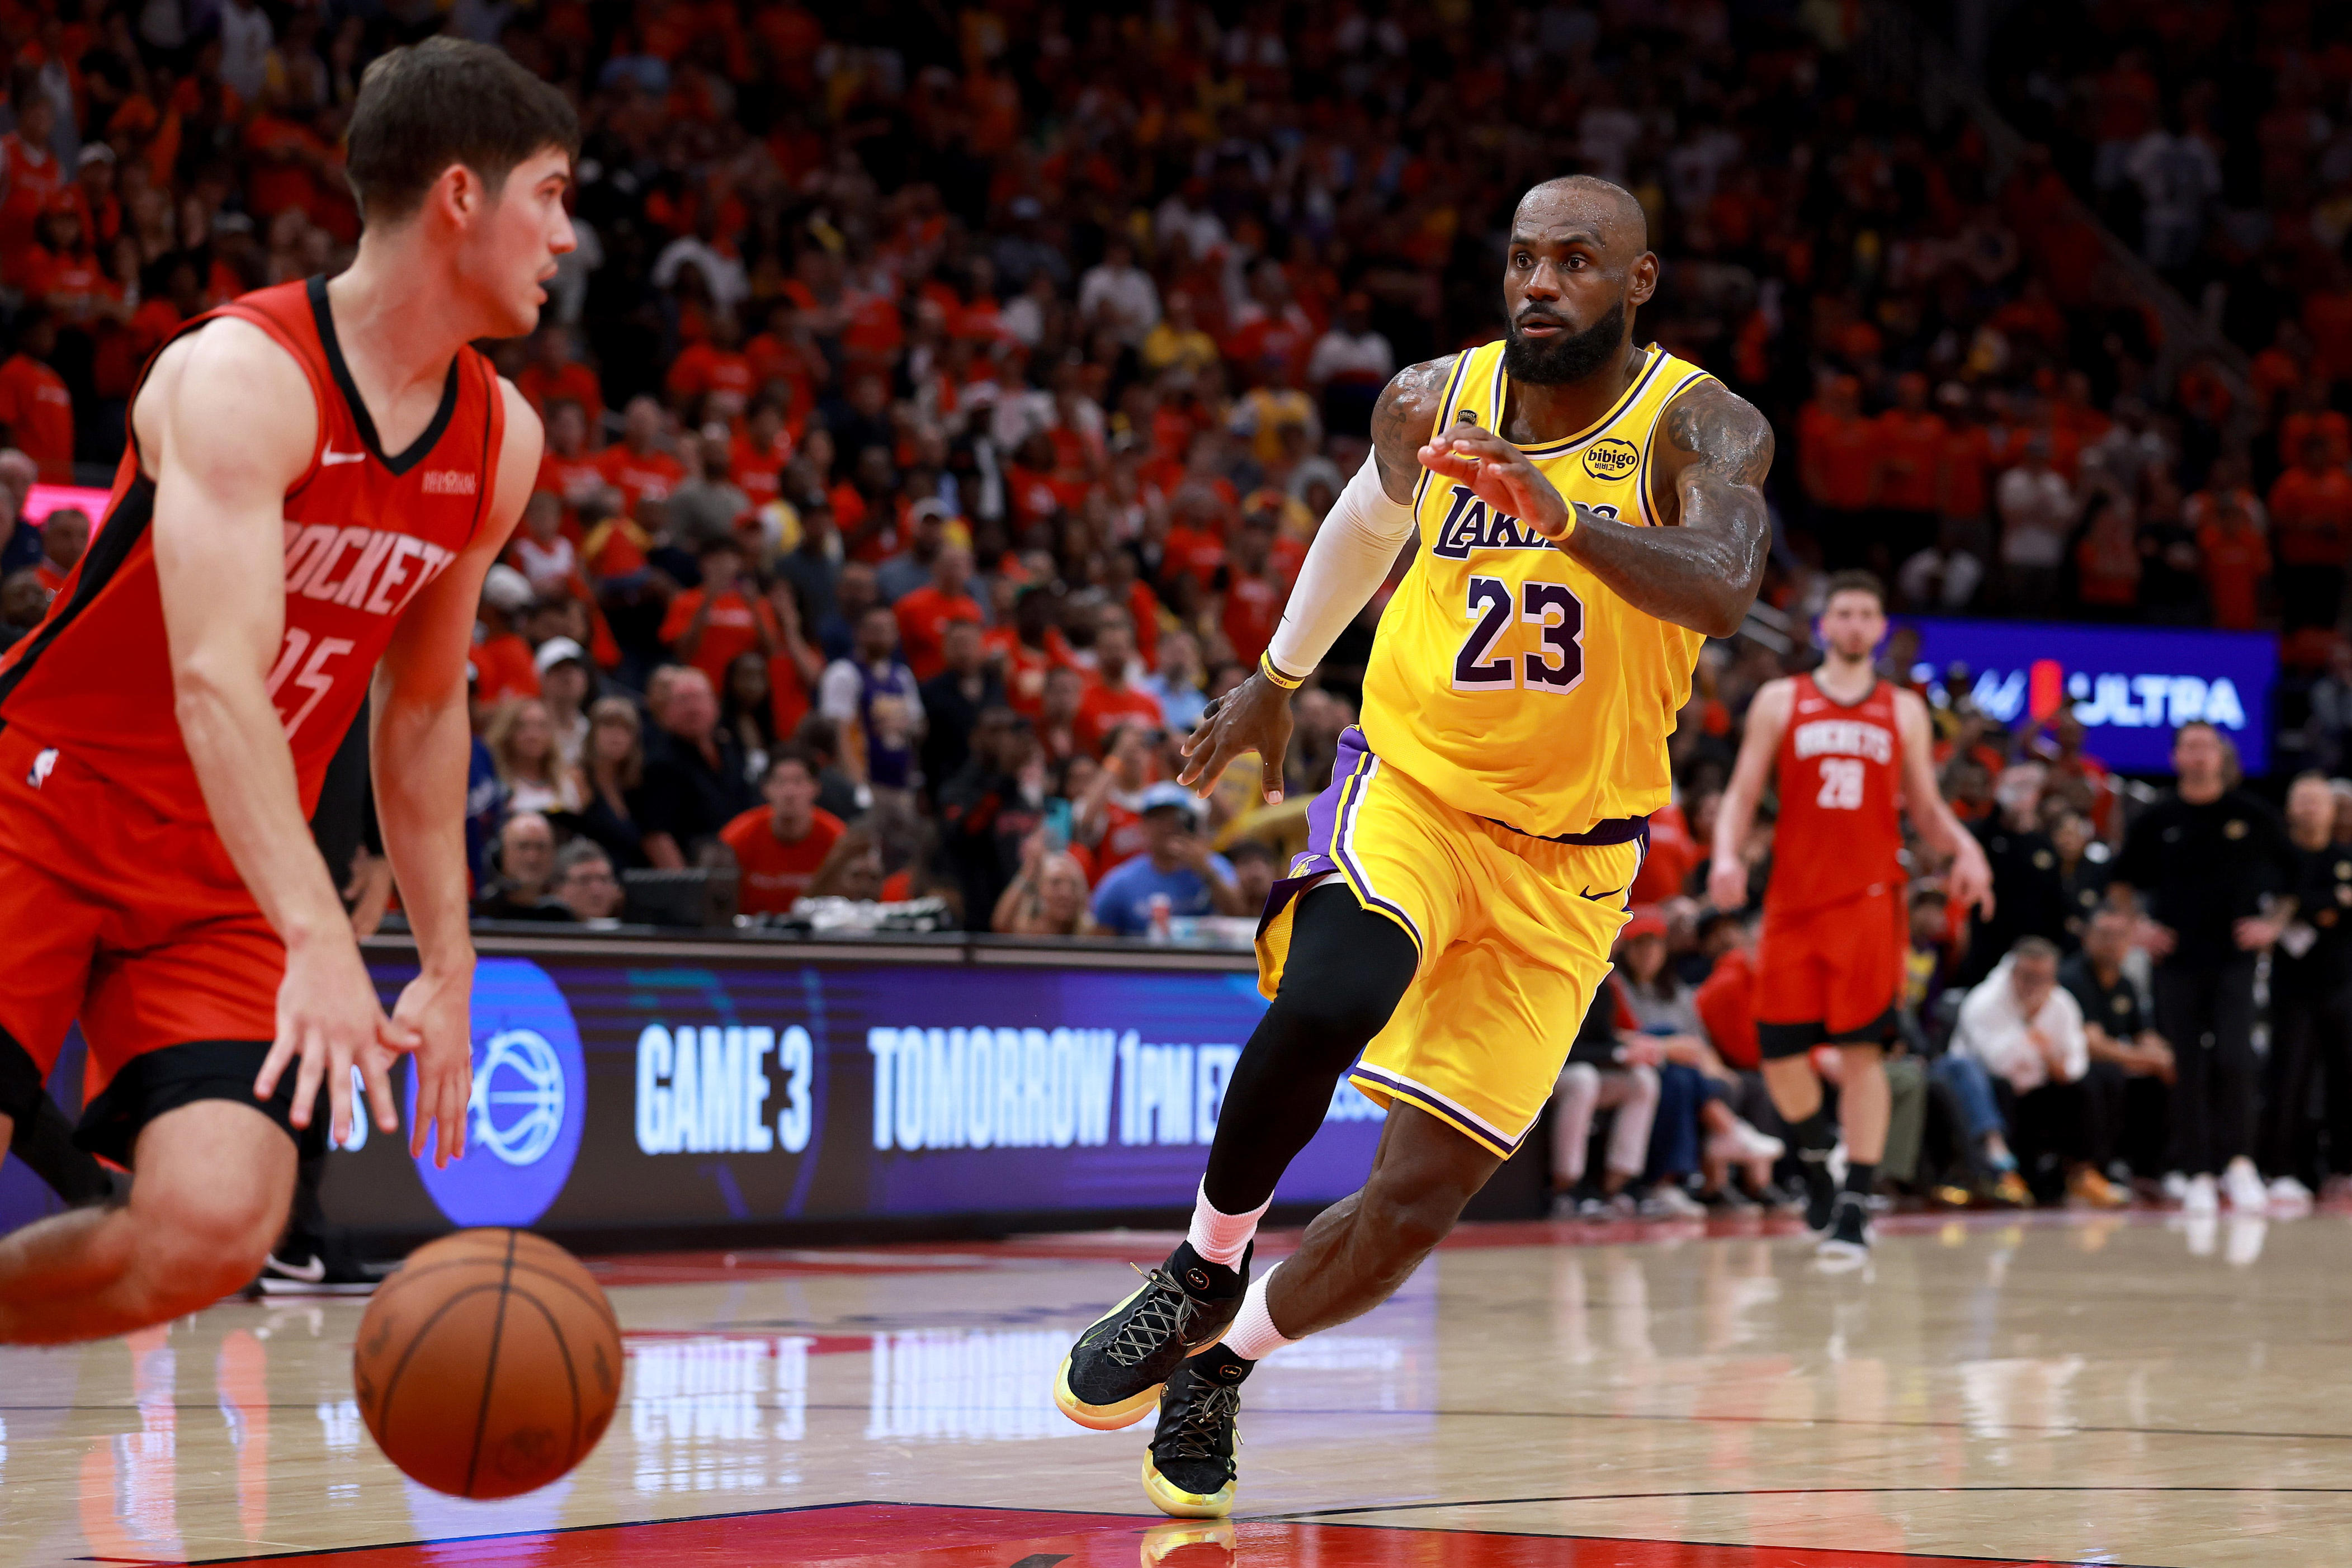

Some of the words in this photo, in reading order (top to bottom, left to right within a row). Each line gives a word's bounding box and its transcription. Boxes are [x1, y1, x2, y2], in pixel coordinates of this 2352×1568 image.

[1588, 448, 1636, 469] bibigo
[1594, 462, 1615, 471] 비비고
[1433, 483, 1620, 561] LAK
[283, 519, 456, 617] OCKET
[1452, 574, 1585, 695] 23
[2068, 671, 2246, 730] ULTRA
[635, 1024, 775, 1156] GAME
[778, 1024, 813, 1154] 3
[867, 1026, 1117, 1151] TOMORROW
[1119, 1028, 1194, 1145] 1PM
